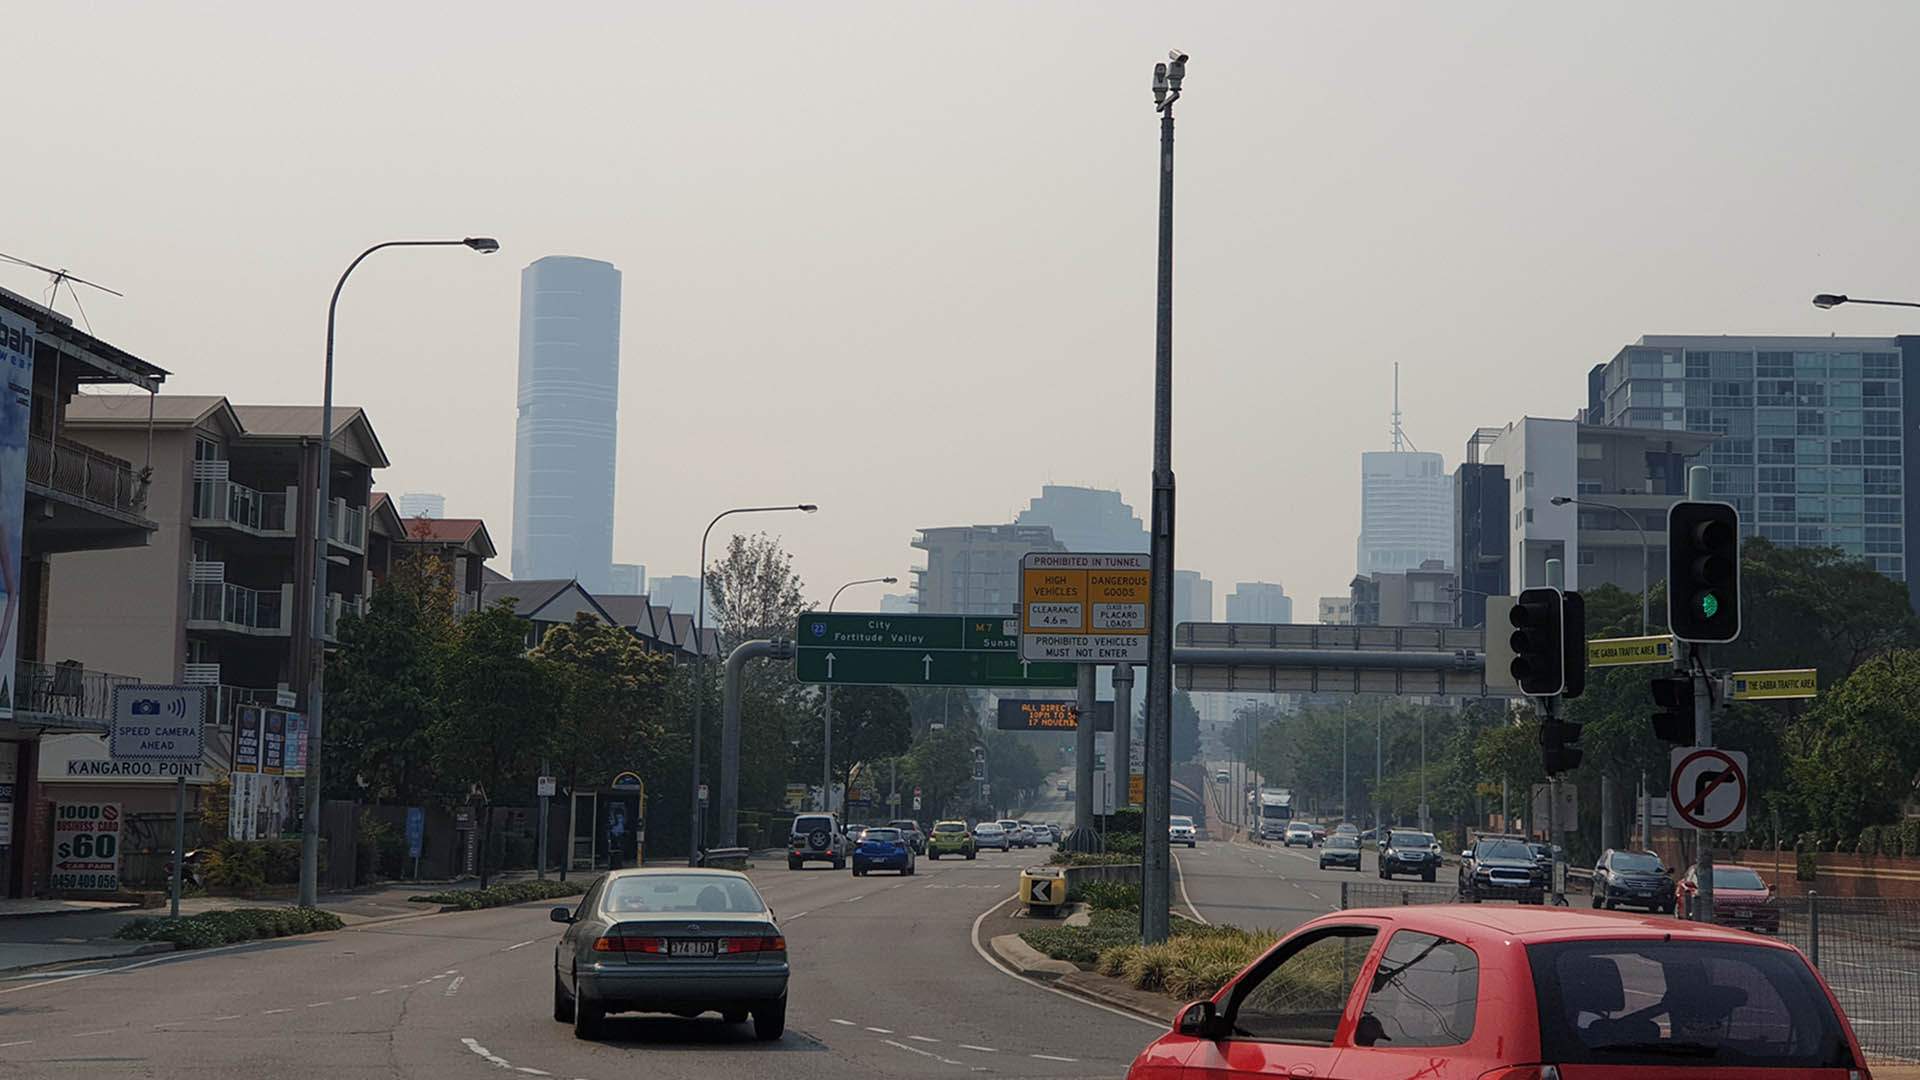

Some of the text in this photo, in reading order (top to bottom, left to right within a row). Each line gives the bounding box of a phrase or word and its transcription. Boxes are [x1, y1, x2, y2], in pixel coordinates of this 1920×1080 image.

[1034, 557, 1141, 567] PROHIBITED IN TUNNEL
[1045, 575, 1067, 584] HIGH
[1091, 576, 1147, 586] DANGEROUS
[1033, 587, 1078, 596] VEHICLES
[1104, 588, 1135, 597] GOODS
[1032, 606, 1079, 614] CLEARANCE
[1101, 611, 1137, 619] PLACARD
[1043, 616, 1058, 625] 4.6
[1105, 620, 1132, 628] LOADS
[868, 620, 892, 631] City
[975, 623, 992, 632] M7
[834, 633, 924, 644] Fortitude Valley
[1036, 637, 1138, 647] PROHIBITED VEHICLES
[983, 639, 1016, 648] Sunsh
[1046, 649, 1128, 657] MUST NOT ENTER
[1590, 650, 1600, 658] THE
[1617, 647, 1641, 656] TRAFFIC
[1641, 645, 1655, 655] AREA
[1748, 682, 1758, 690] THE
[1778, 680, 1800, 689] TRAFFIC
[1800, 679, 1815, 688] AREA
[1022, 703, 1037, 712] ALL
[1054, 711, 1064, 719] TO
[1029, 719, 1078, 727] 17 NOVEMB
[120, 726, 196, 737] SPEED CAMERA
[140, 741, 175, 750] AHEAD
[68, 761, 202, 776] KANGAROO POINT
[58, 805, 99, 819] 1000
[58, 833, 116, 859] $60
